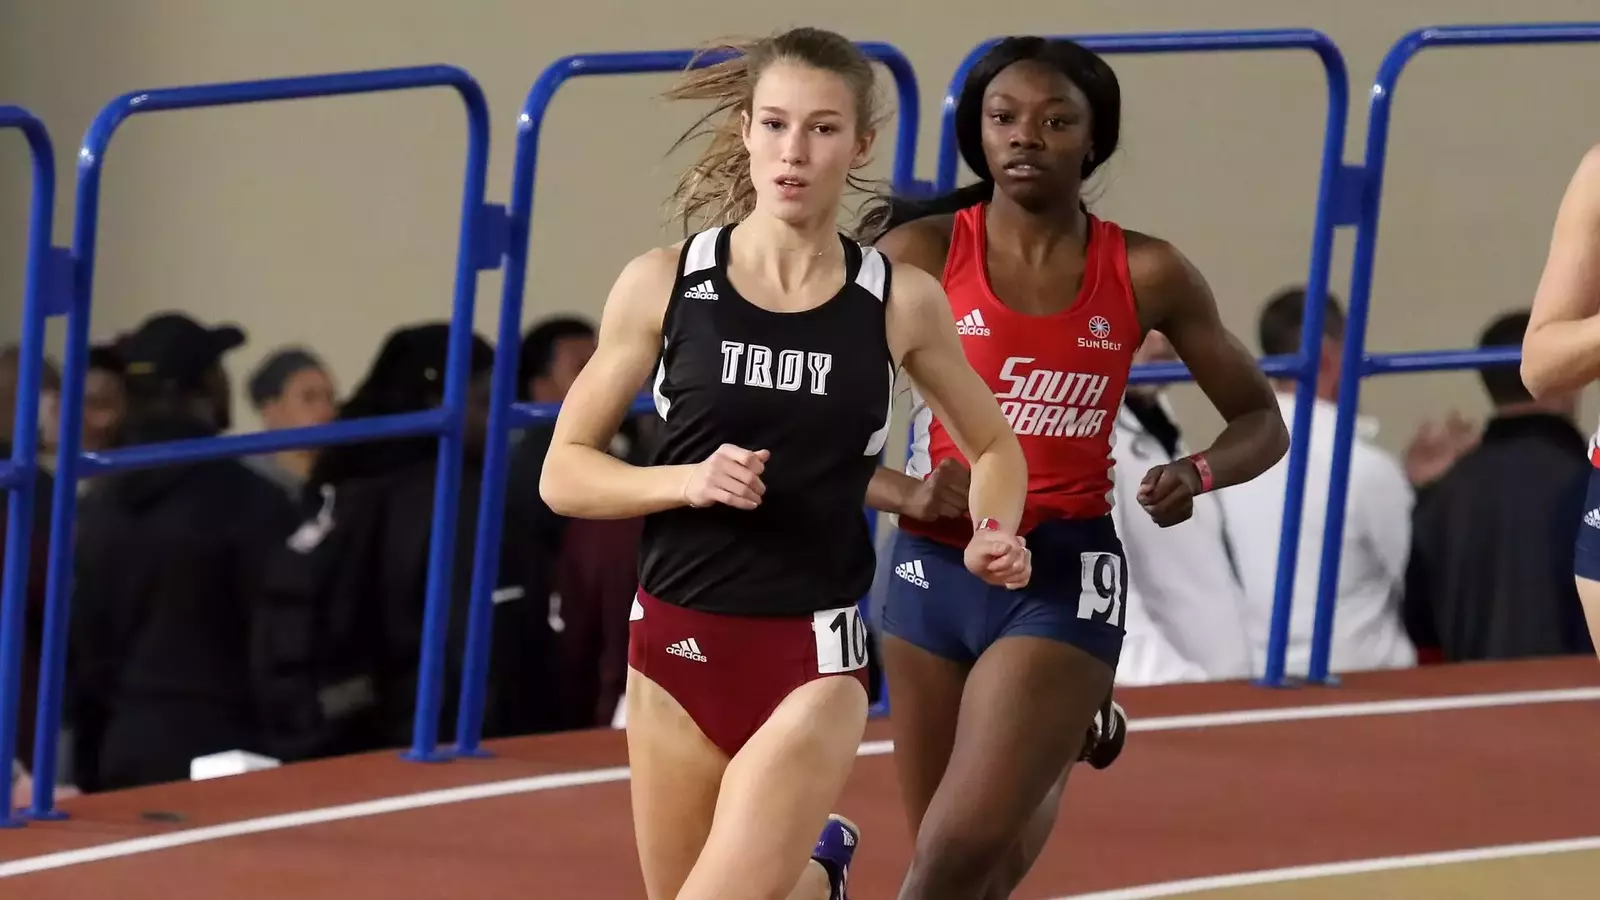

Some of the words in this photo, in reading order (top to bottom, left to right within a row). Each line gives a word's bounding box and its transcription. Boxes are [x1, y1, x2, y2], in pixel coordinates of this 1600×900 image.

[684, 290, 719, 301] adidas
[957, 324, 991, 337] didas
[721, 340, 833, 396] TROY
[993, 356, 1109, 407] SOUTH
[894, 565, 930, 590] adidas
[1092, 553, 1117, 622] 9
[665, 645, 708, 663] adidas
[829, 611, 866, 668] 10
